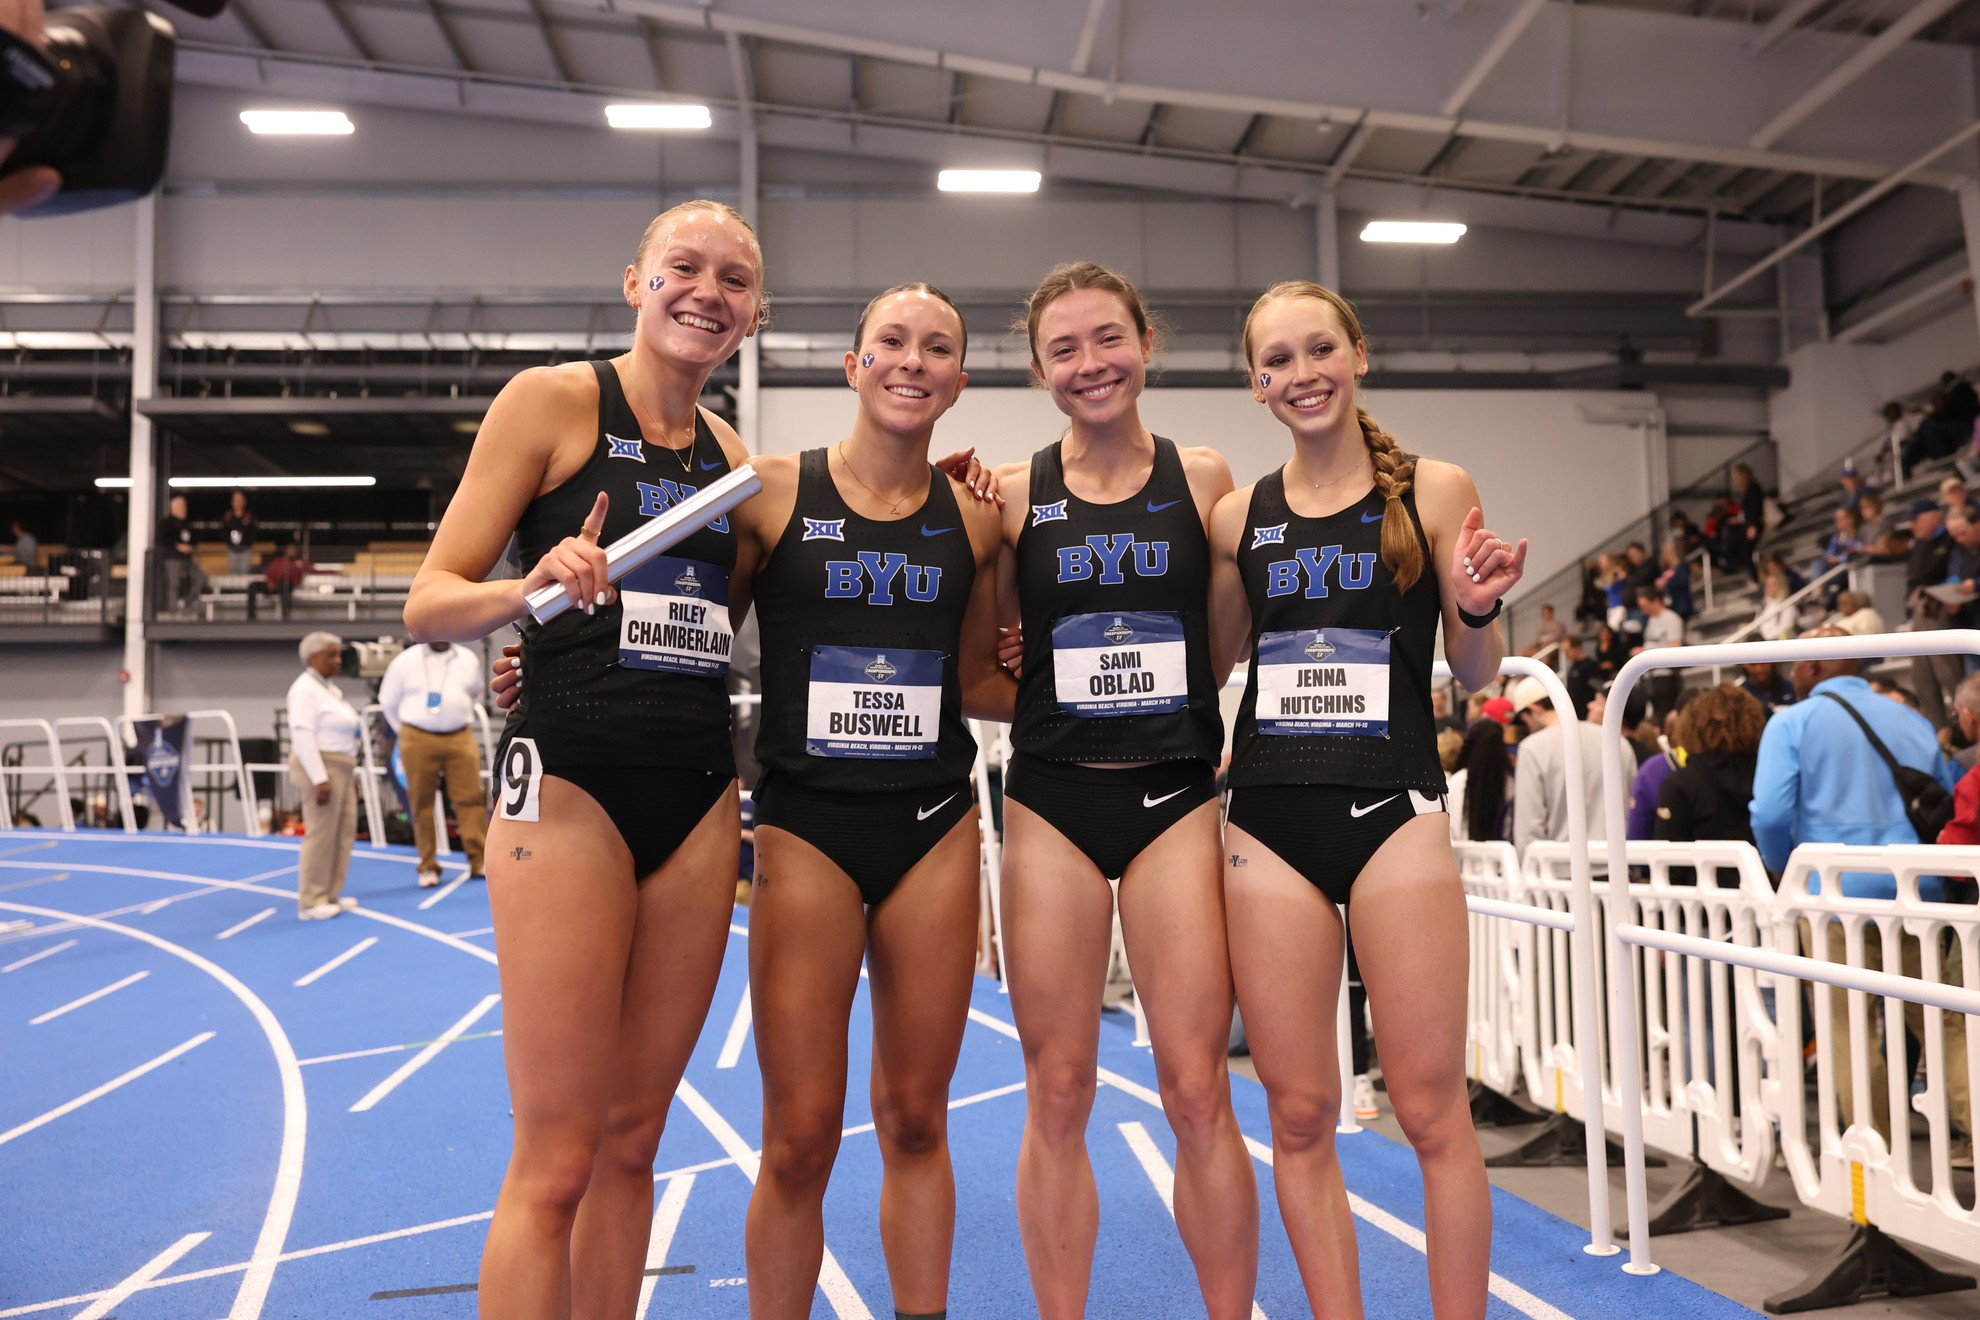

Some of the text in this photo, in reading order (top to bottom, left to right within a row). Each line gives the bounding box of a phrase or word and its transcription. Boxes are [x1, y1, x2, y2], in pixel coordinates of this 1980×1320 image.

[610, 438, 642, 459] XII
[1035, 501, 1065, 522] XII
[805, 521, 842, 538] XII
[1256, 526, 1285, 544] XII
[1057, 533, 1170, 585] BYU
[825, 551, 942, 606] BYU
[1267, 545, 1376, 599] BYU
[669, 602, 707, 625] RILEY
[627, 620, 731, 656] CHAMBERLAIN
[1099, 651, 1142, 670] SAMI
[1089, 672, 1155, 696] OBLAD
[1296, 668, 1347, 688] JENNA
[853, 690, 905, 711] TESSA
[1280, 694, 1366, 715] HUTCHINS
[829, 712, 923, 737] BUSWELL
[505, 742, 532, 816] 9
